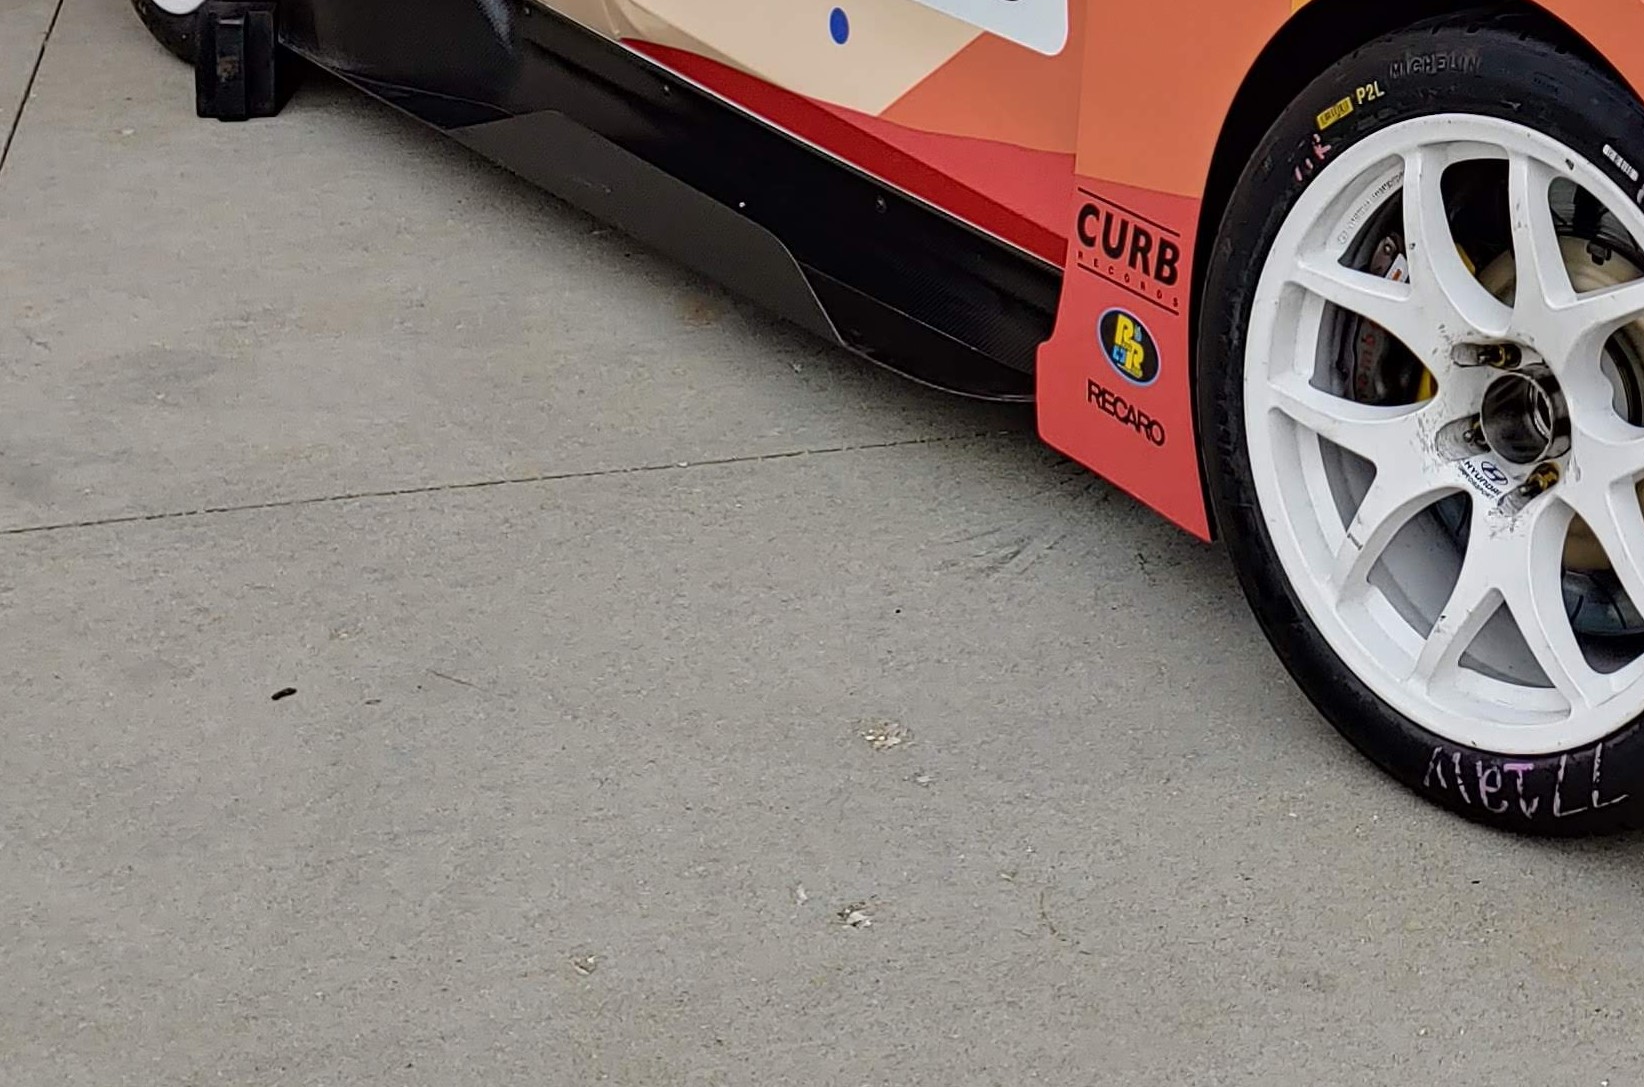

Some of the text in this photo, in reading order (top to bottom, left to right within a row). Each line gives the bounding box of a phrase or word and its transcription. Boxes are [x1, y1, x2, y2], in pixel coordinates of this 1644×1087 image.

[1389, 49, 1481, 78] MICHELIN
[1356, 80, 1385, 105] P2L
[1077, 203, 1180, 287] CURB
[1077, 250, 1180, 308] RECORDS
[1087, 378, 1166, 447] RECARO
[1464, 460, 1501, 496] HYUNDAI
